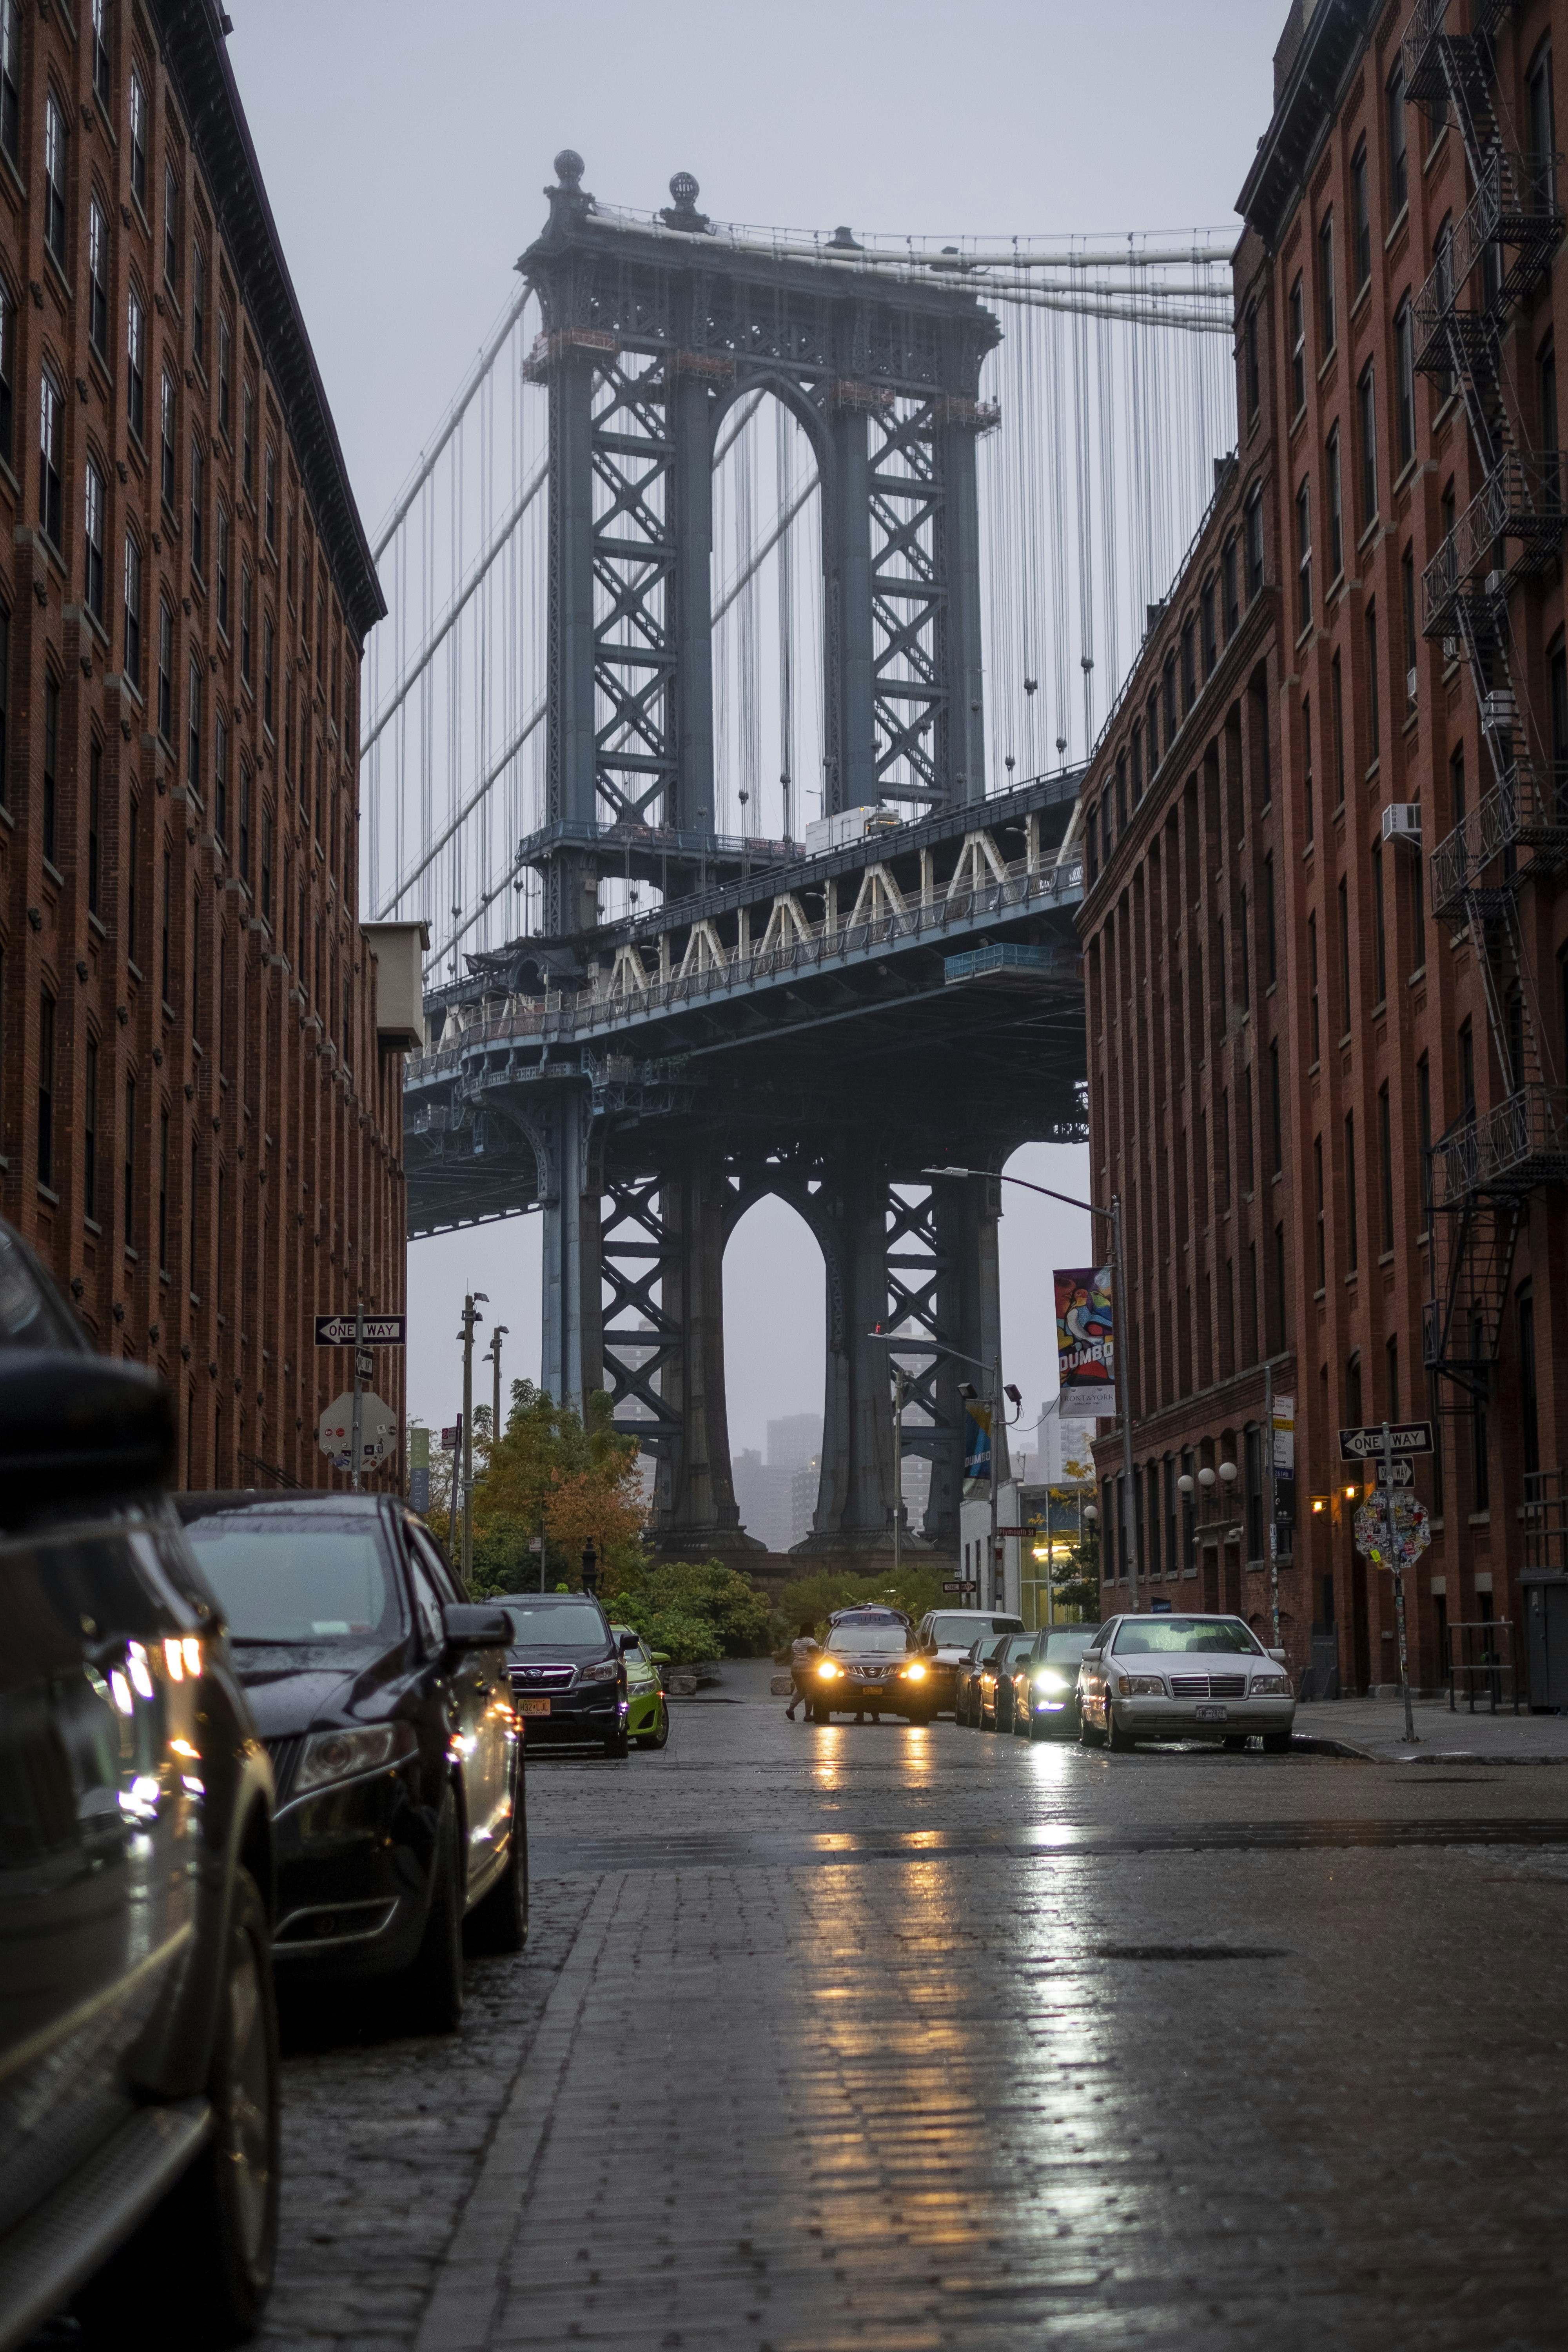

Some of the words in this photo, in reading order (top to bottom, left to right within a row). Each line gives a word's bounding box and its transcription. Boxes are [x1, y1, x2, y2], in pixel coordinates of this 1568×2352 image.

[329, 1325, 354, 1336] ONE
[367, 1325, 394, 1336] WAY
[1059, 1342, 1113, 1372] DUMBO
[1355, 1437, 1380, 1450] ONE
[1392, 1432, 1419, 1446] WAY
[965, 1450, 991, 1467] DUMBO
[1396, 1467, 1408, 1478] WAY
